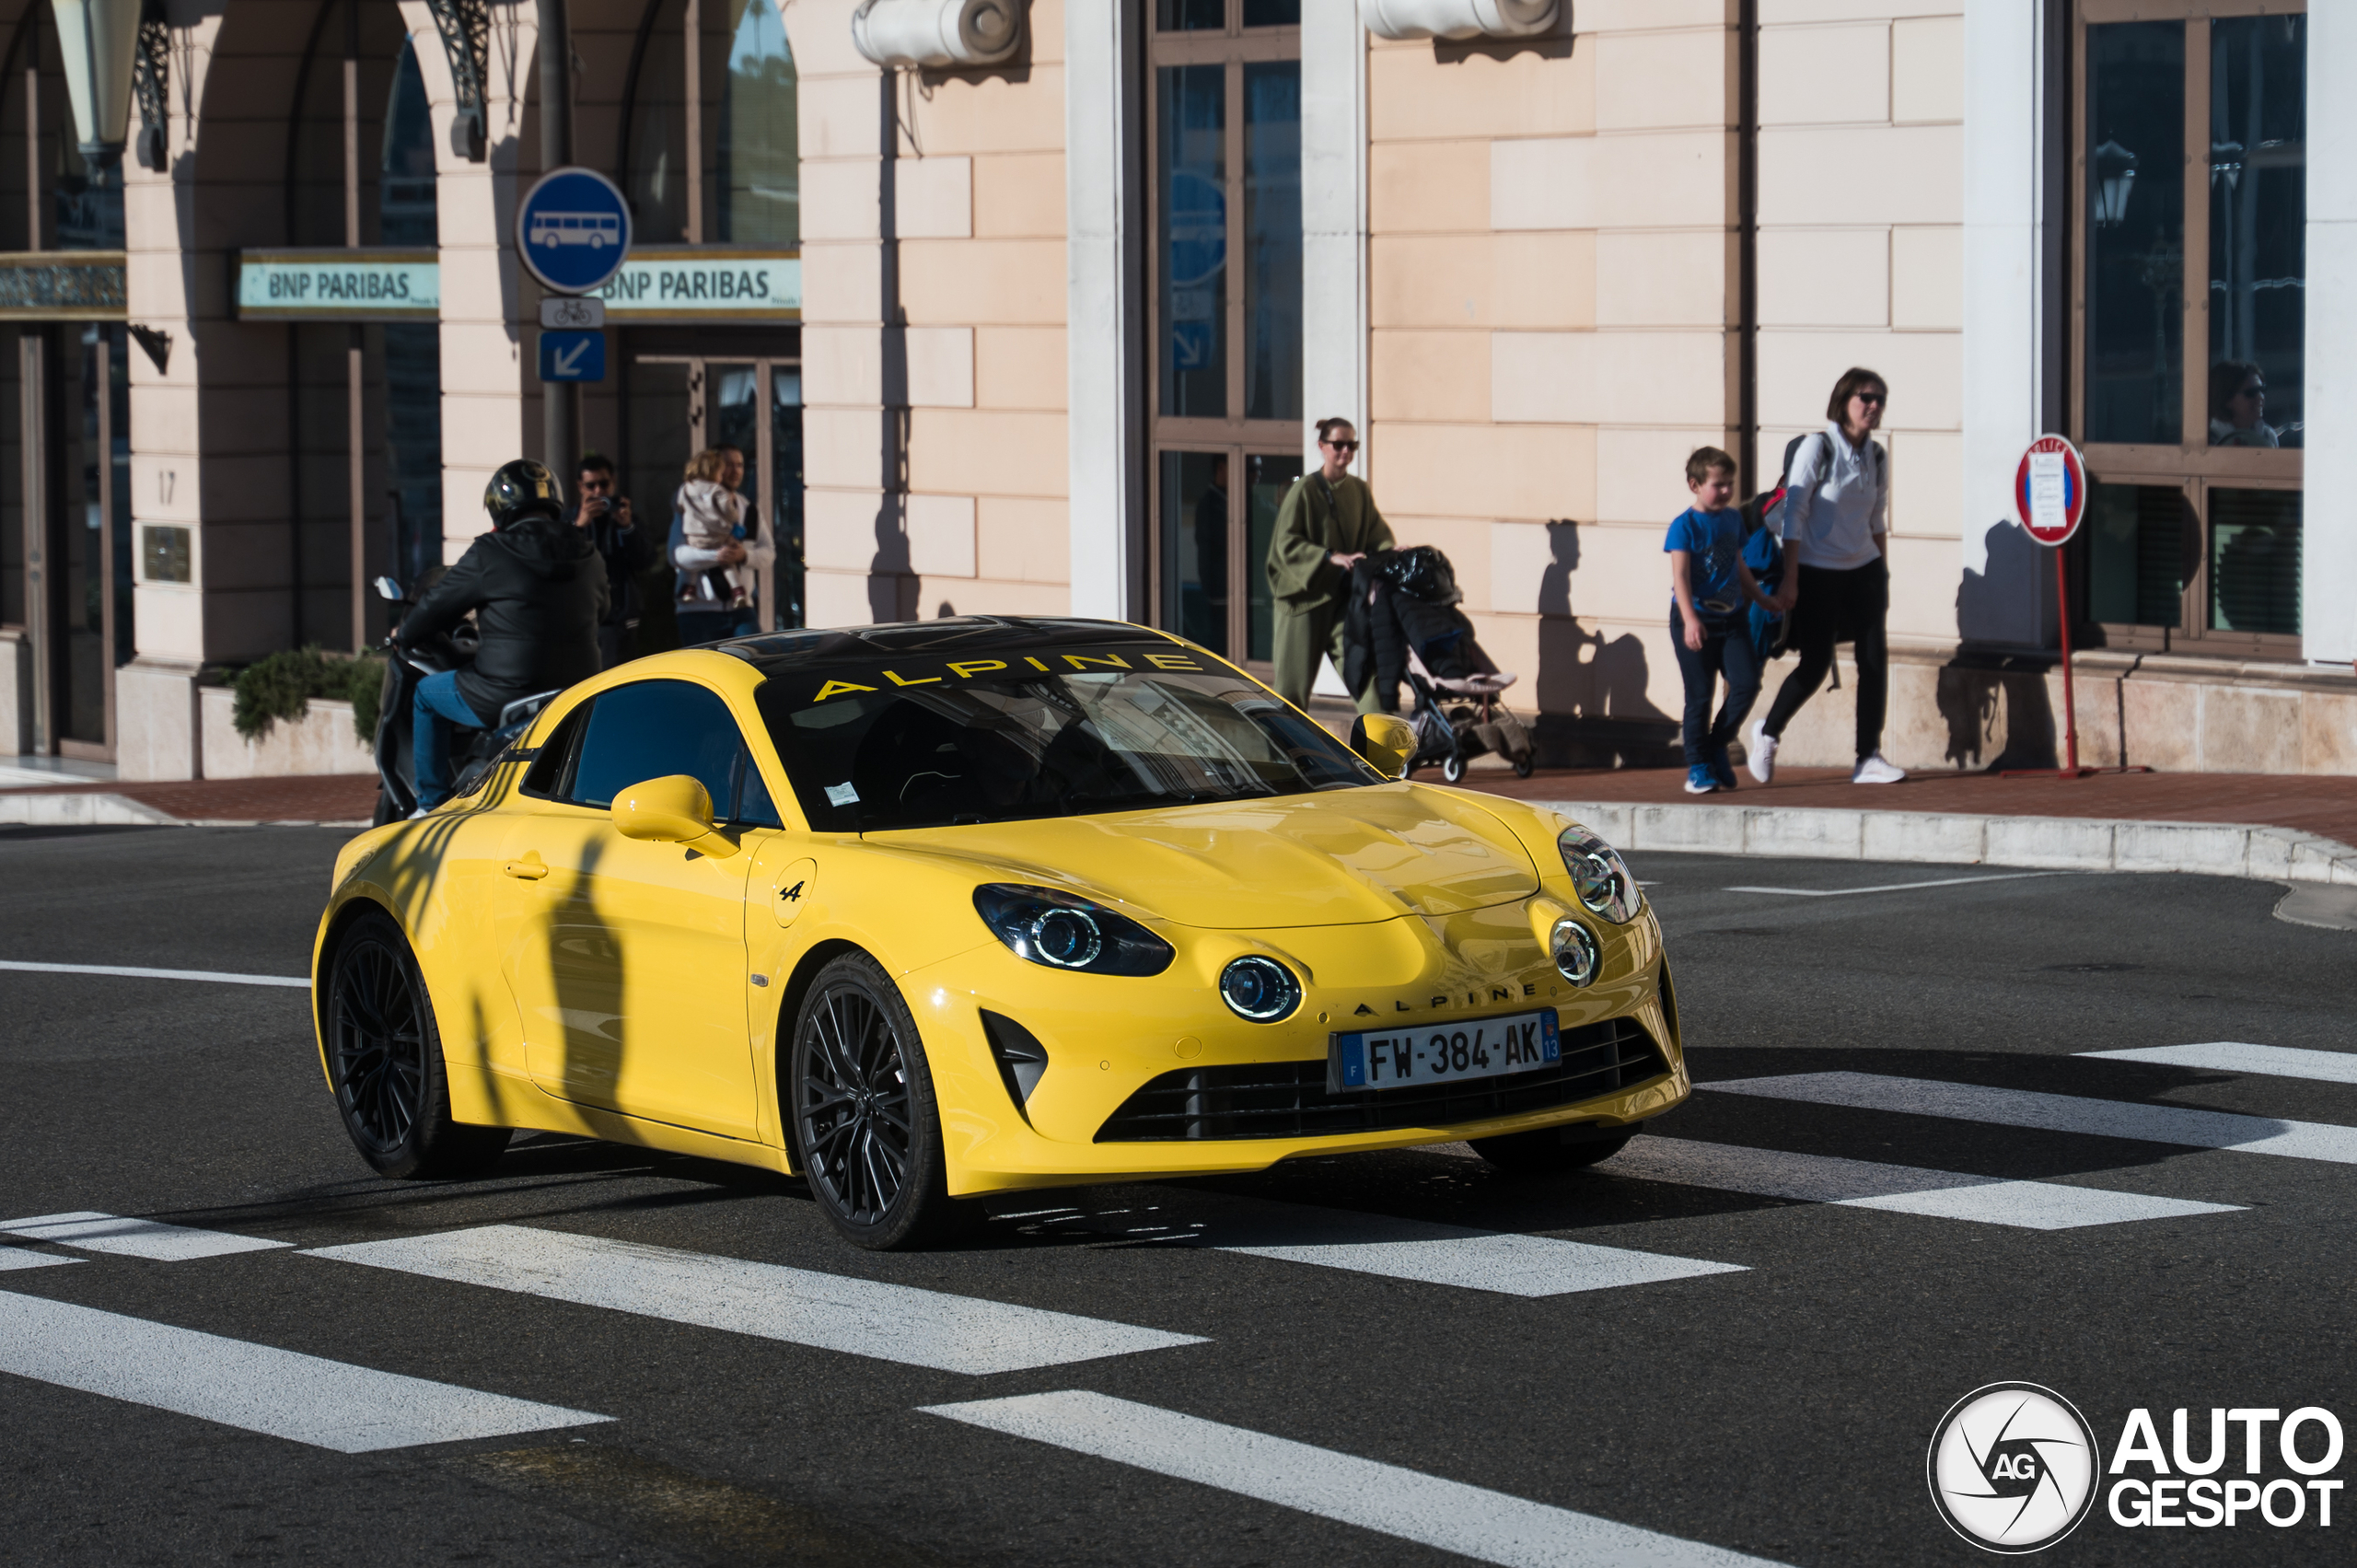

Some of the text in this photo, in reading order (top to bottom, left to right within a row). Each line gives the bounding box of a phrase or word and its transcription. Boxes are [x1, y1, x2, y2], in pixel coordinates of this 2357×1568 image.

[269, 272, 410, 299] BNP PARIBAS
[602, 271, 770, 300] BNP PARIBAS
[158, 470, 176, 505] 17
[813, 653, 1204, 703] ALPINE
[1354, 983, 1537, 1016] ALPINE
[1369, 1022, 1540, 1082] FW-384-AK
[1544, 1039, 1558, 1059] 13
[1350, 1065, 1356, 1077] F
